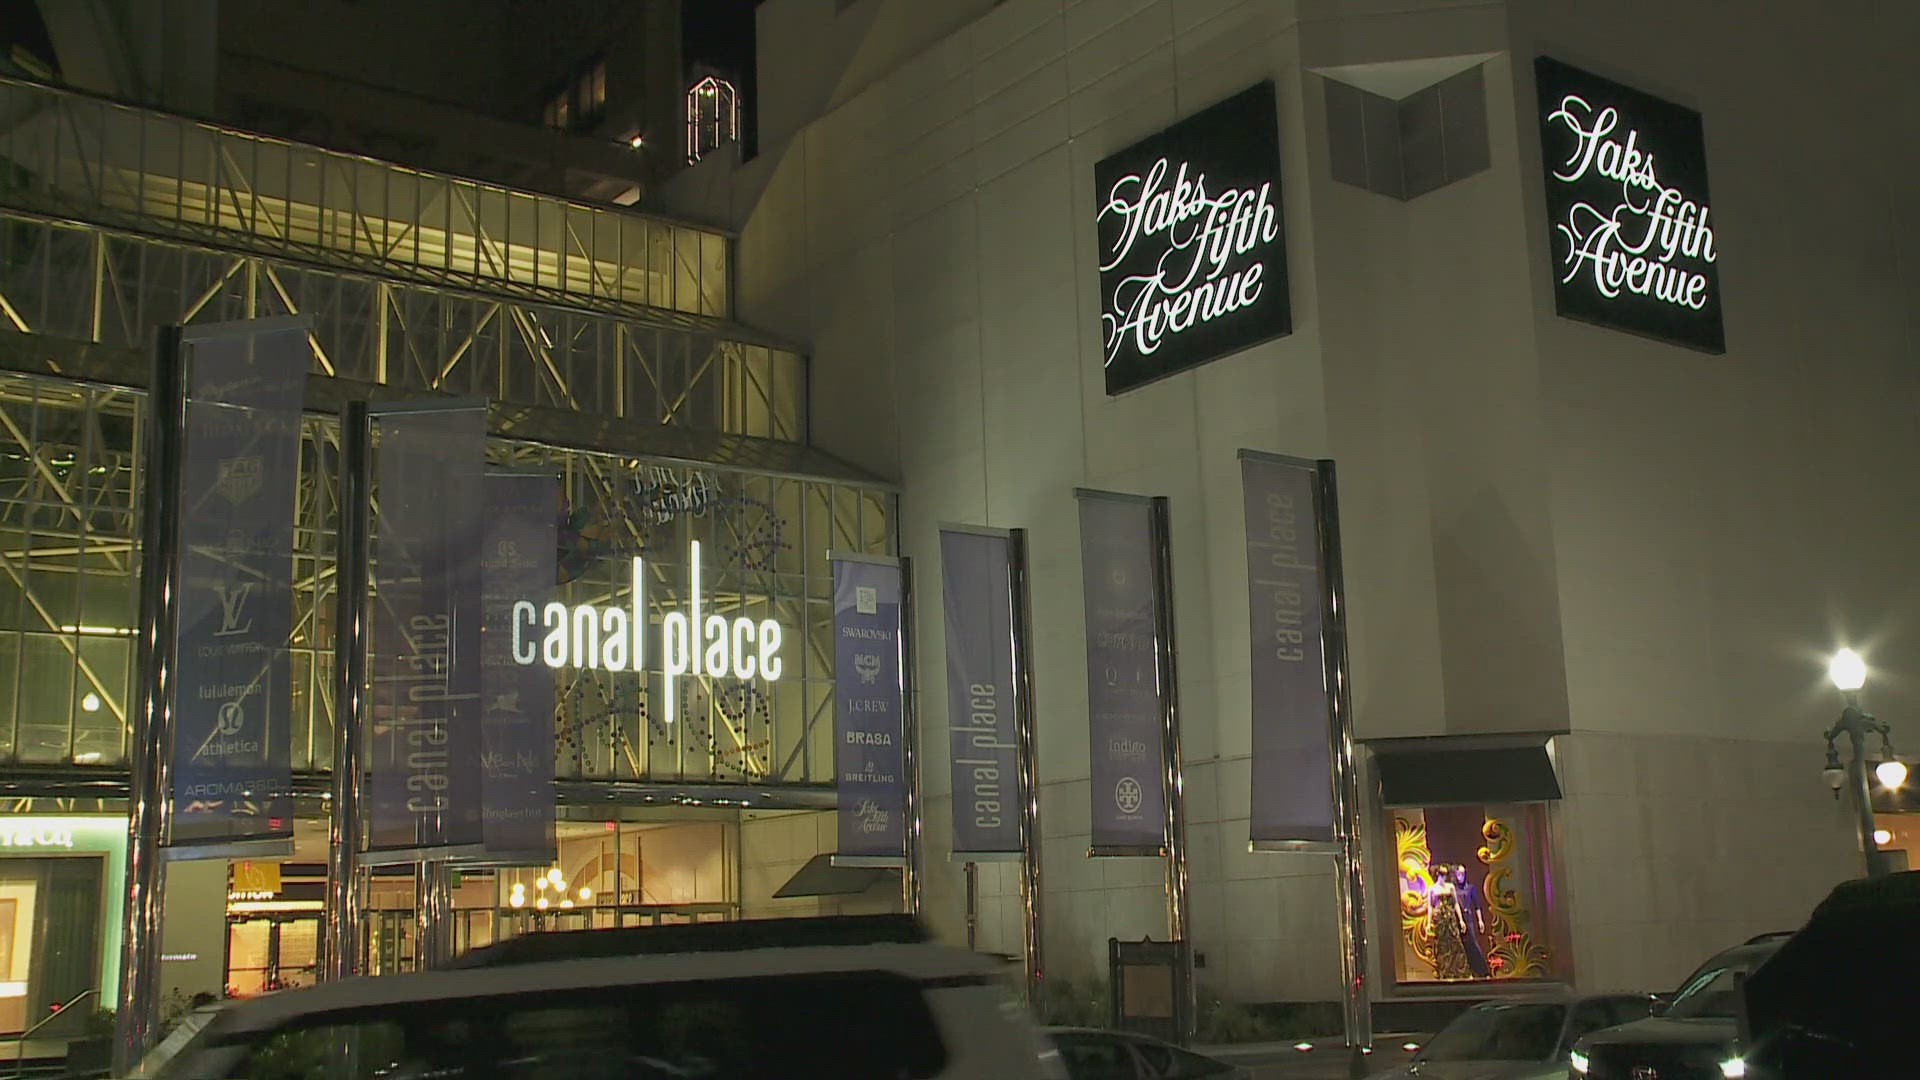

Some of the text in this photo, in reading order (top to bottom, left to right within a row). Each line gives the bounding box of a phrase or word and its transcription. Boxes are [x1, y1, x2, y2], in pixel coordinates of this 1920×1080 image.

[1548, 95, 1656, 190] Saks
[1097, 156, 1208, 272] Saks
[1557, 202, 1707, 310] Avenue
[1101, 262, 1263, 369] Avenue
[1248, 493, 1317, 662] canal place
[512, 540, 782, 723] canal place
[842, 627, 892, 641] SWAROVSKI
[854, 653, 880, 667] MCM
[199, 682, 262, 699] lululemon
[374, 614, 481, 813] canal place
[848, 698, 890, 714] J.CREW
[202, 739, 258, 757] athletica
[846, 731, 892, 746] BRASA
[949, 683, 1018, 828] canal place
[1108, 739, 1146, 756] Indigo
[845, 773, 895, 784] BREITLING
